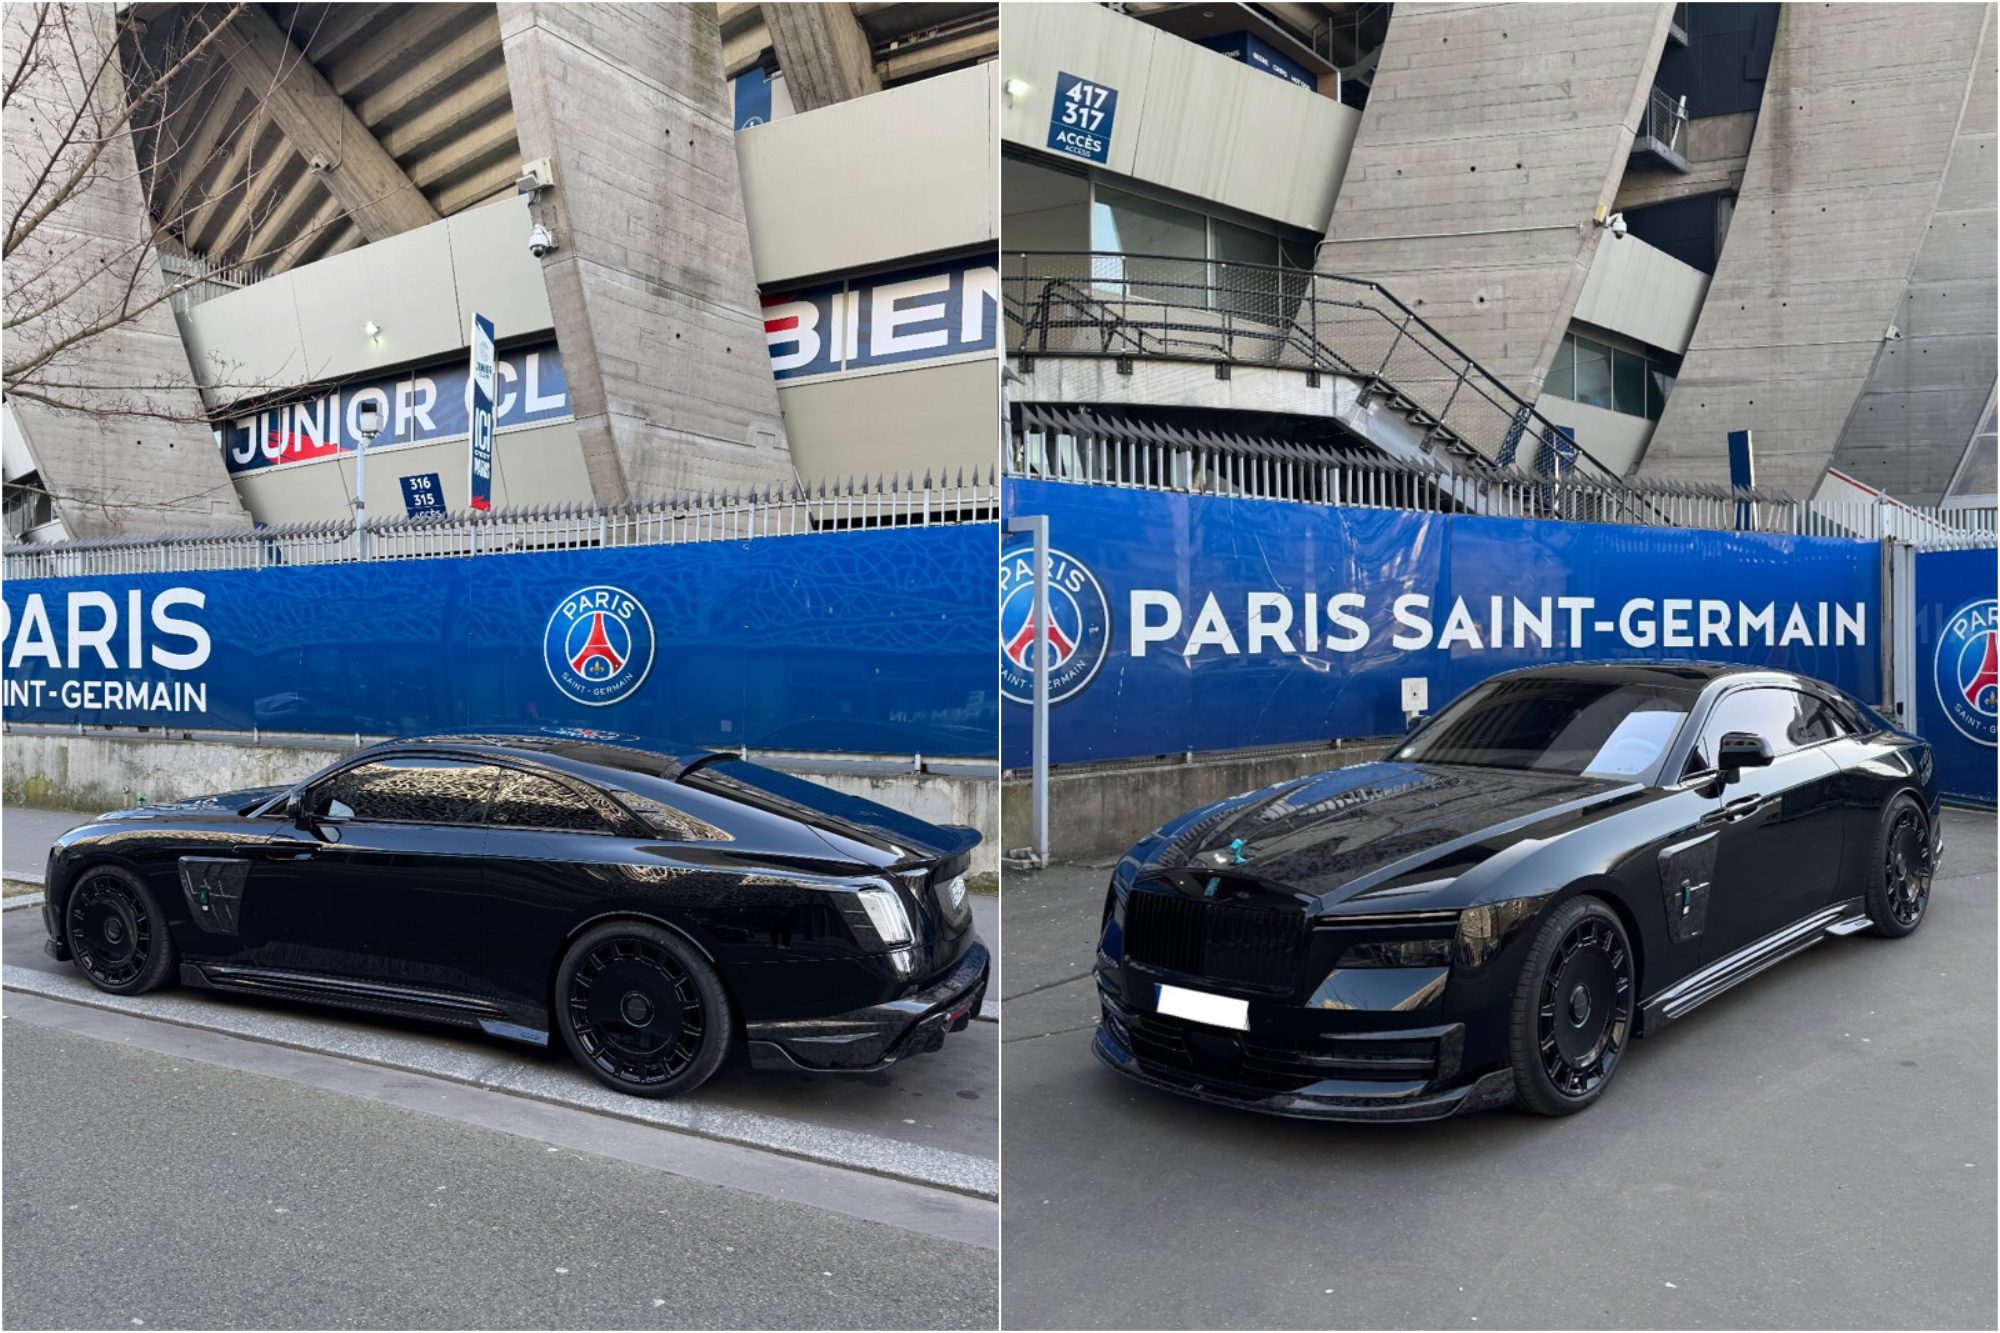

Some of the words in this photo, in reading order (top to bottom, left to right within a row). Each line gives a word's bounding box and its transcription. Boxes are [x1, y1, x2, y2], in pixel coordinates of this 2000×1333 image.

[1065, 81, 1109, 109] 417
[1062, 101, 1105, 131] 317
[1056, 131, 1102, 152] ACCÈS
[1065, 145, 1091, 157] ACCESS
[232, 378, 437, 464] JUNIOR
[474, 407, 491, 452] ICI
[410, 476, 431, 490] 316
[413, 493, 435, 506] 315
[562, 591, 635, 620] PARIS
[2, 587, 211, 670] ARIS
[1130, 589, 1371, 657] PARIS
[1392, 593, 1866, 650] SAINT-GERMAIN
[1953, 703, 1998, 734] SAINT-G
